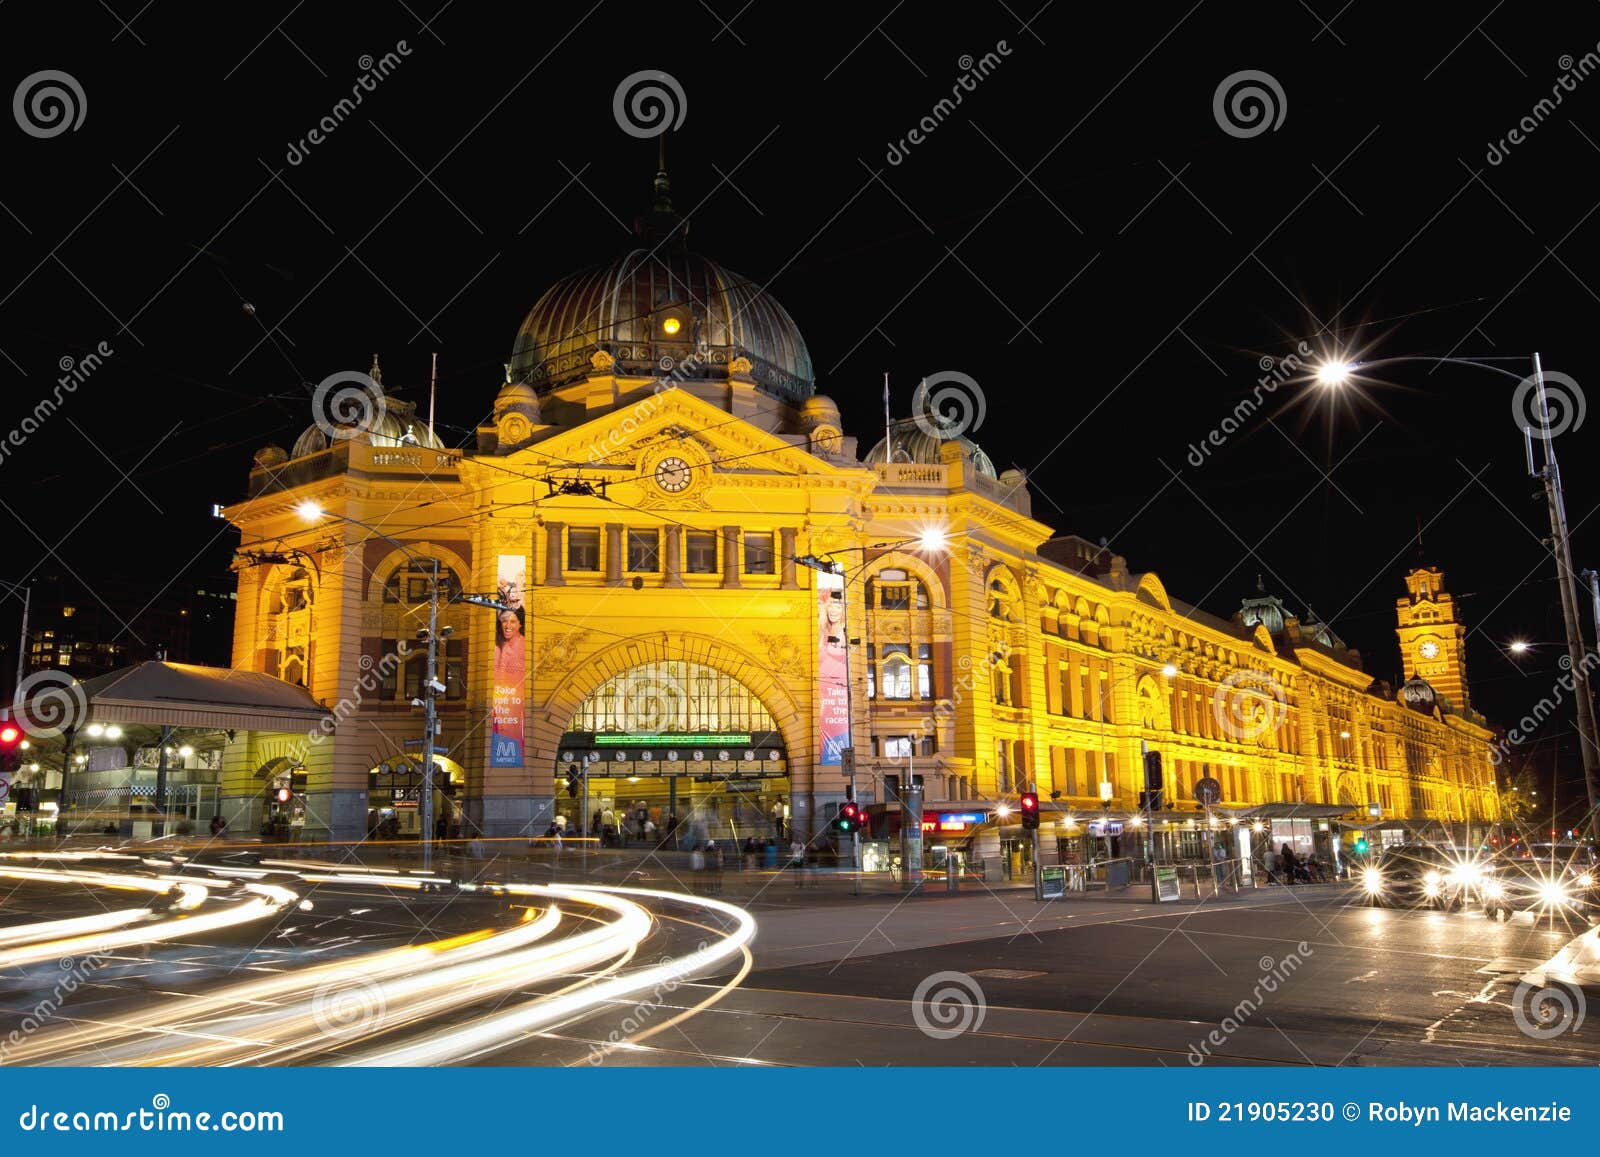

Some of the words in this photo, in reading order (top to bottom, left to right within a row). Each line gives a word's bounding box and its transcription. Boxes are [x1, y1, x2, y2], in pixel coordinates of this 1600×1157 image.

[495, 686, 516, 695] Take
[826, 687, 847, 697] Take
[494, 697, 509, 705] me
[512, 696, 521, 705] to
[838, 696, 847, 705] to
[494, 705, 510, 714] the
[833, 706, 847, 715] the
[493, 717, 519, 725] races
[825, 717, 848, 725] races
